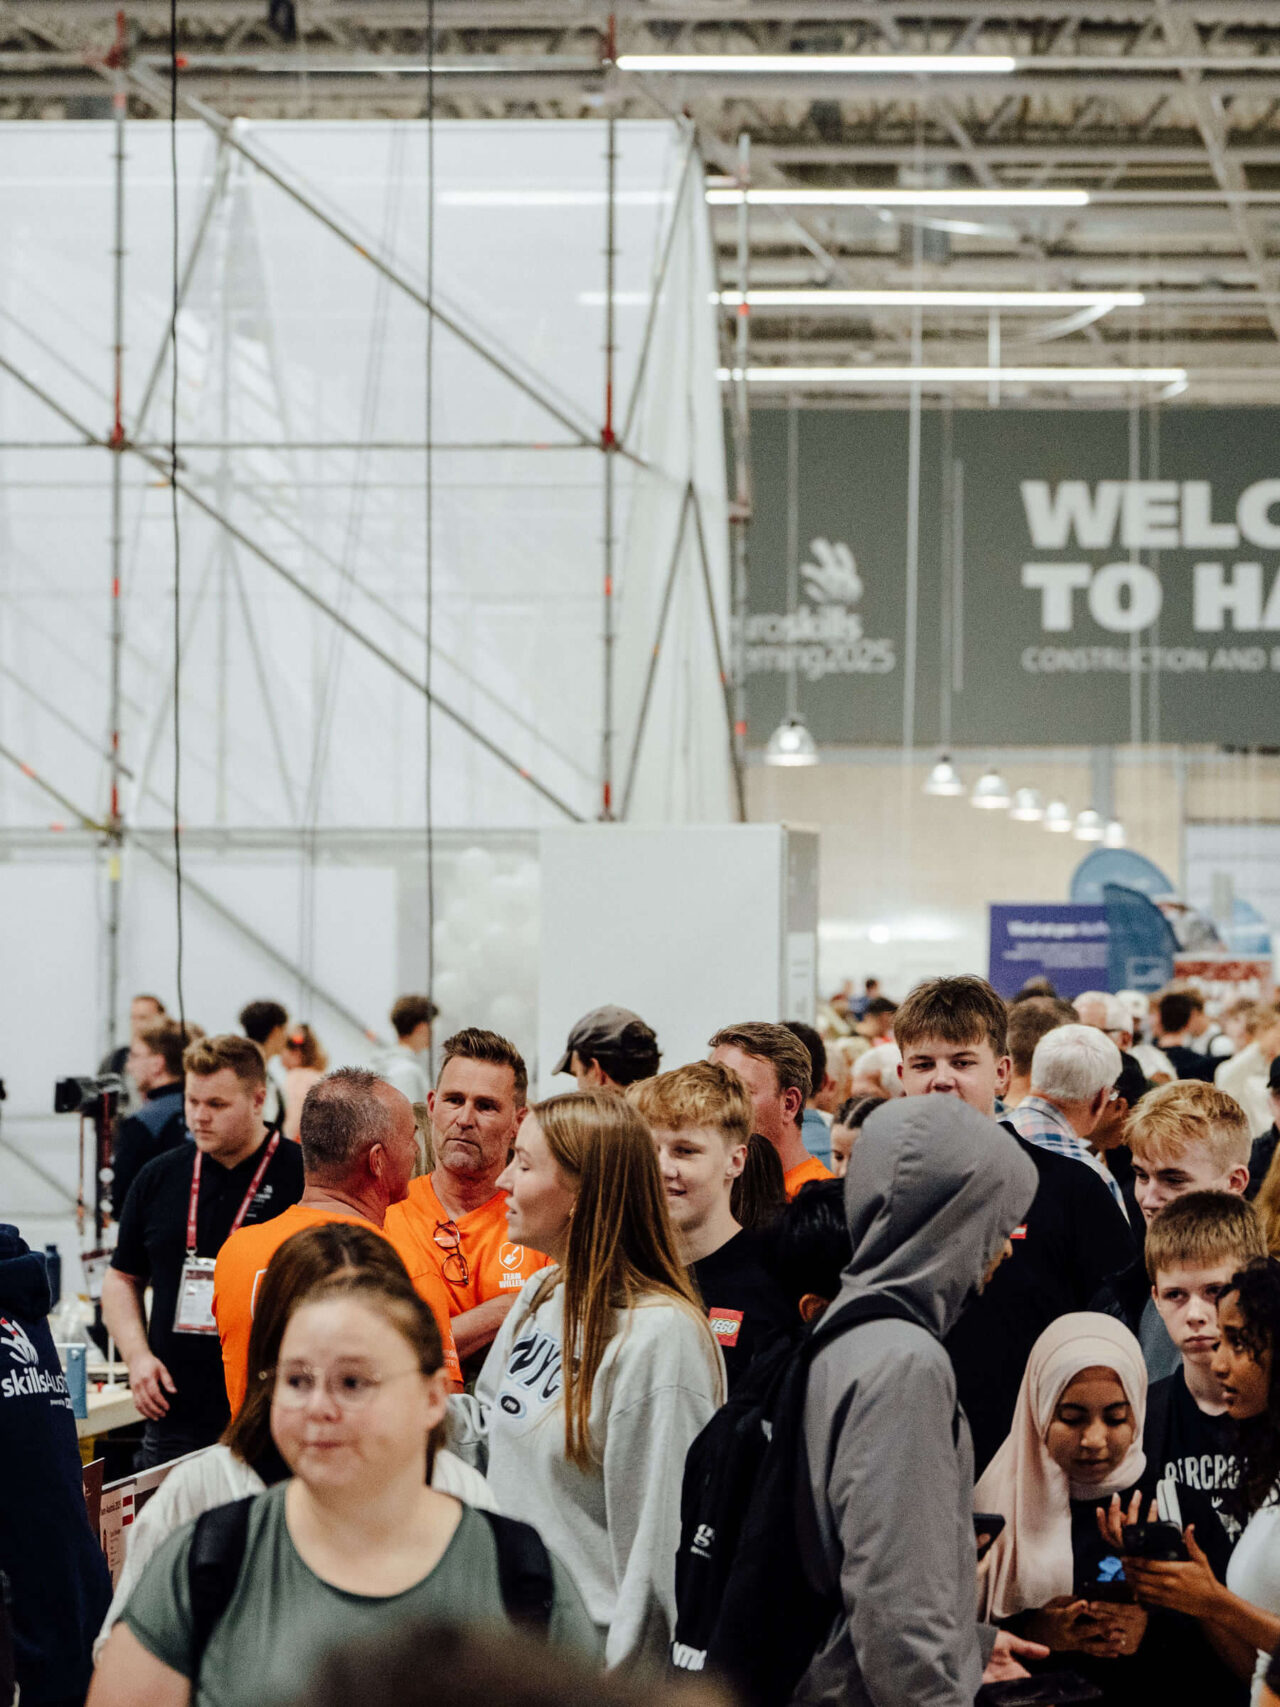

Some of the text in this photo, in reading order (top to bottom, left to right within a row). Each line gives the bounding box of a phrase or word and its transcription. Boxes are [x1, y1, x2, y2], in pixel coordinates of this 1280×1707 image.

[1020, 561, 1164, 633] TO
[1020, 646, 1209, 674] CONSTRUCTION
[1209, 646, 1268, 674] AND
[502, 1272, 522, 1281] TEAM
[710, 1319, 738, 1334] LEGO
